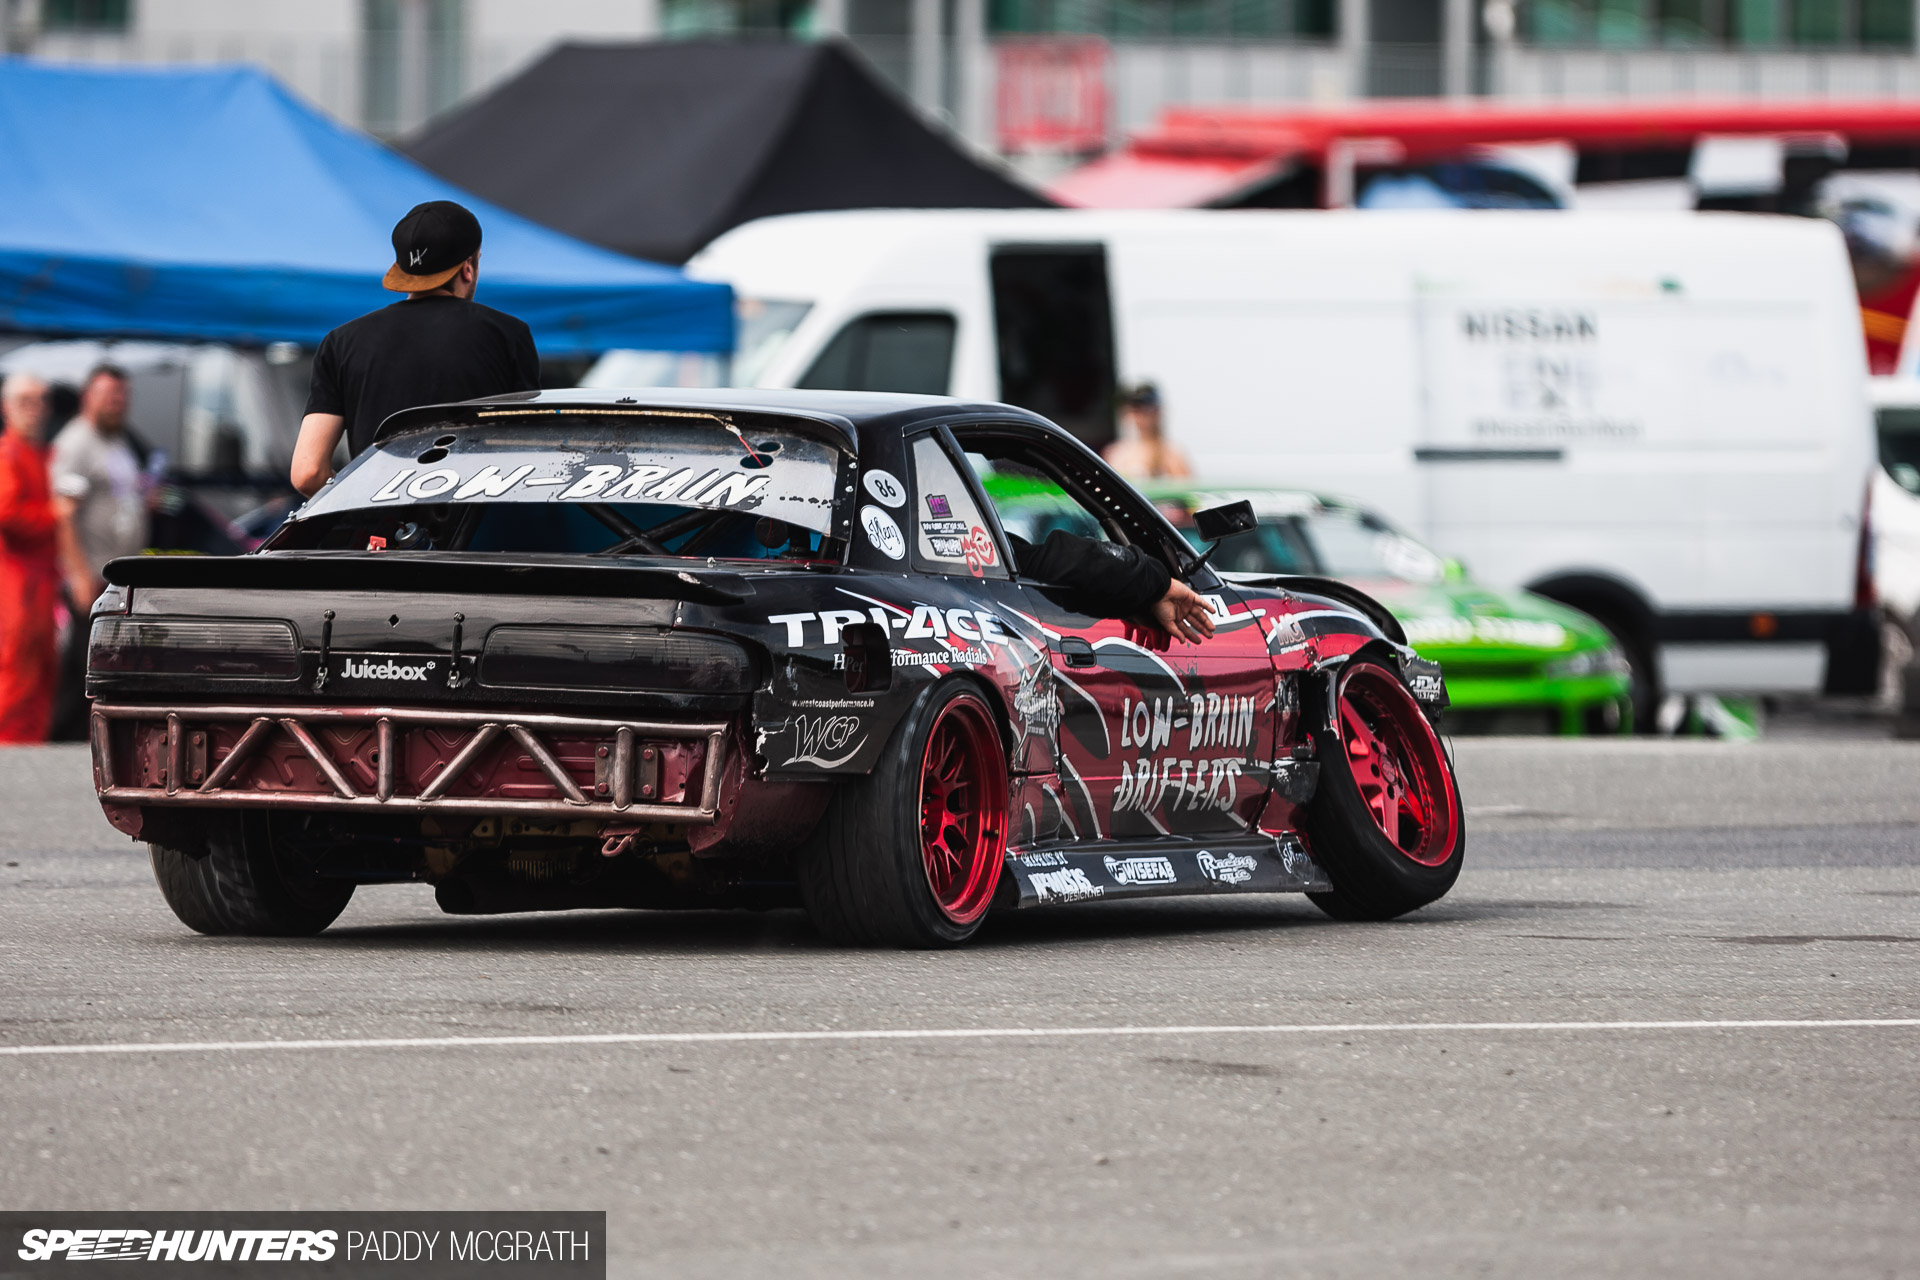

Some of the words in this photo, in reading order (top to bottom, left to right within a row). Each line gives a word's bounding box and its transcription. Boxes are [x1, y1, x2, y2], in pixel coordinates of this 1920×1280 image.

[1463, 312, 1596, 338] NISSAN
[370, 464, 771, 506] LOW-BRAIN
[875, 479, 897, 498] 86
[950, 646, 988, 665] Radials
[340, 658, 428, 681] Juicebox
[1121, 692, 1255, 752] LOW-BRAIN
[795, 714, 860, 762] WCP
[1112, 757, 1243, 812] DRIFTERS
[1122, 861, 1175, 880] WISEFAB
[1196, 850, 1258, 879] Racing
